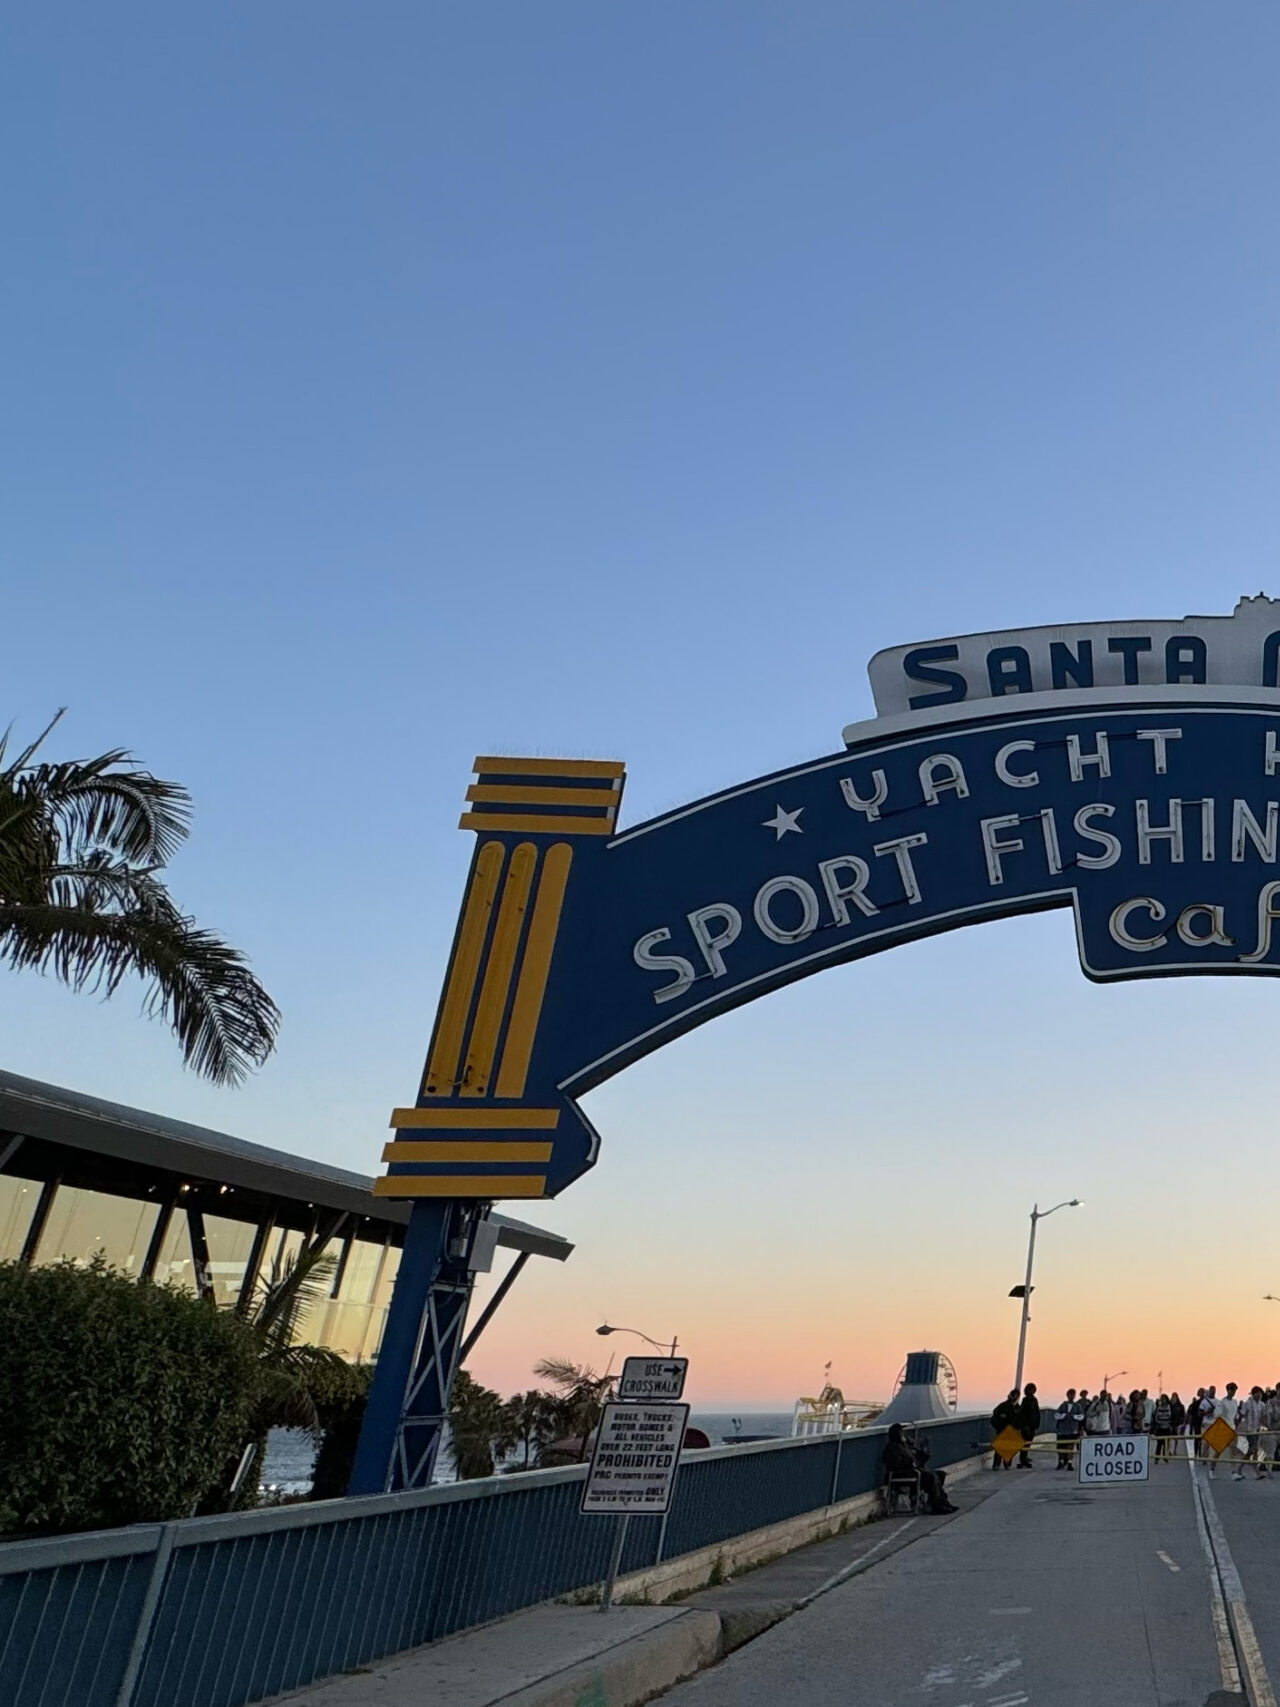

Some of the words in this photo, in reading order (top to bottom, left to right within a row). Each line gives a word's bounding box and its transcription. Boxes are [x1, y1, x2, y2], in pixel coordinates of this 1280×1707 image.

[902, 634, 1208, 711] SANTA
[839, 727, 1183, 823] YACHT
[633, 832, 928, 1004] SPORT
[645, 1364, 664, 1377] USE
[624, 1380, 679, 1393] CROSSWALK
[610, 1423, 636, 1431] MOTOR
[614, 1433, 629, 1441] ALL
[631, 1433, 665, 1441] VEHICLES
[600, 1443, 620, 1451] OVER
[622, 1443, 633, 1451] 22
[635, 1443, 653, 1451] FEET
[655, 1443, 675, 1451] LONG
[1094, 1442, 1135, 1457] ROAD
[596, 1454, 673, 1468] PROHIBITED
[1085, 1460, 1143, 1476] CLOSED
